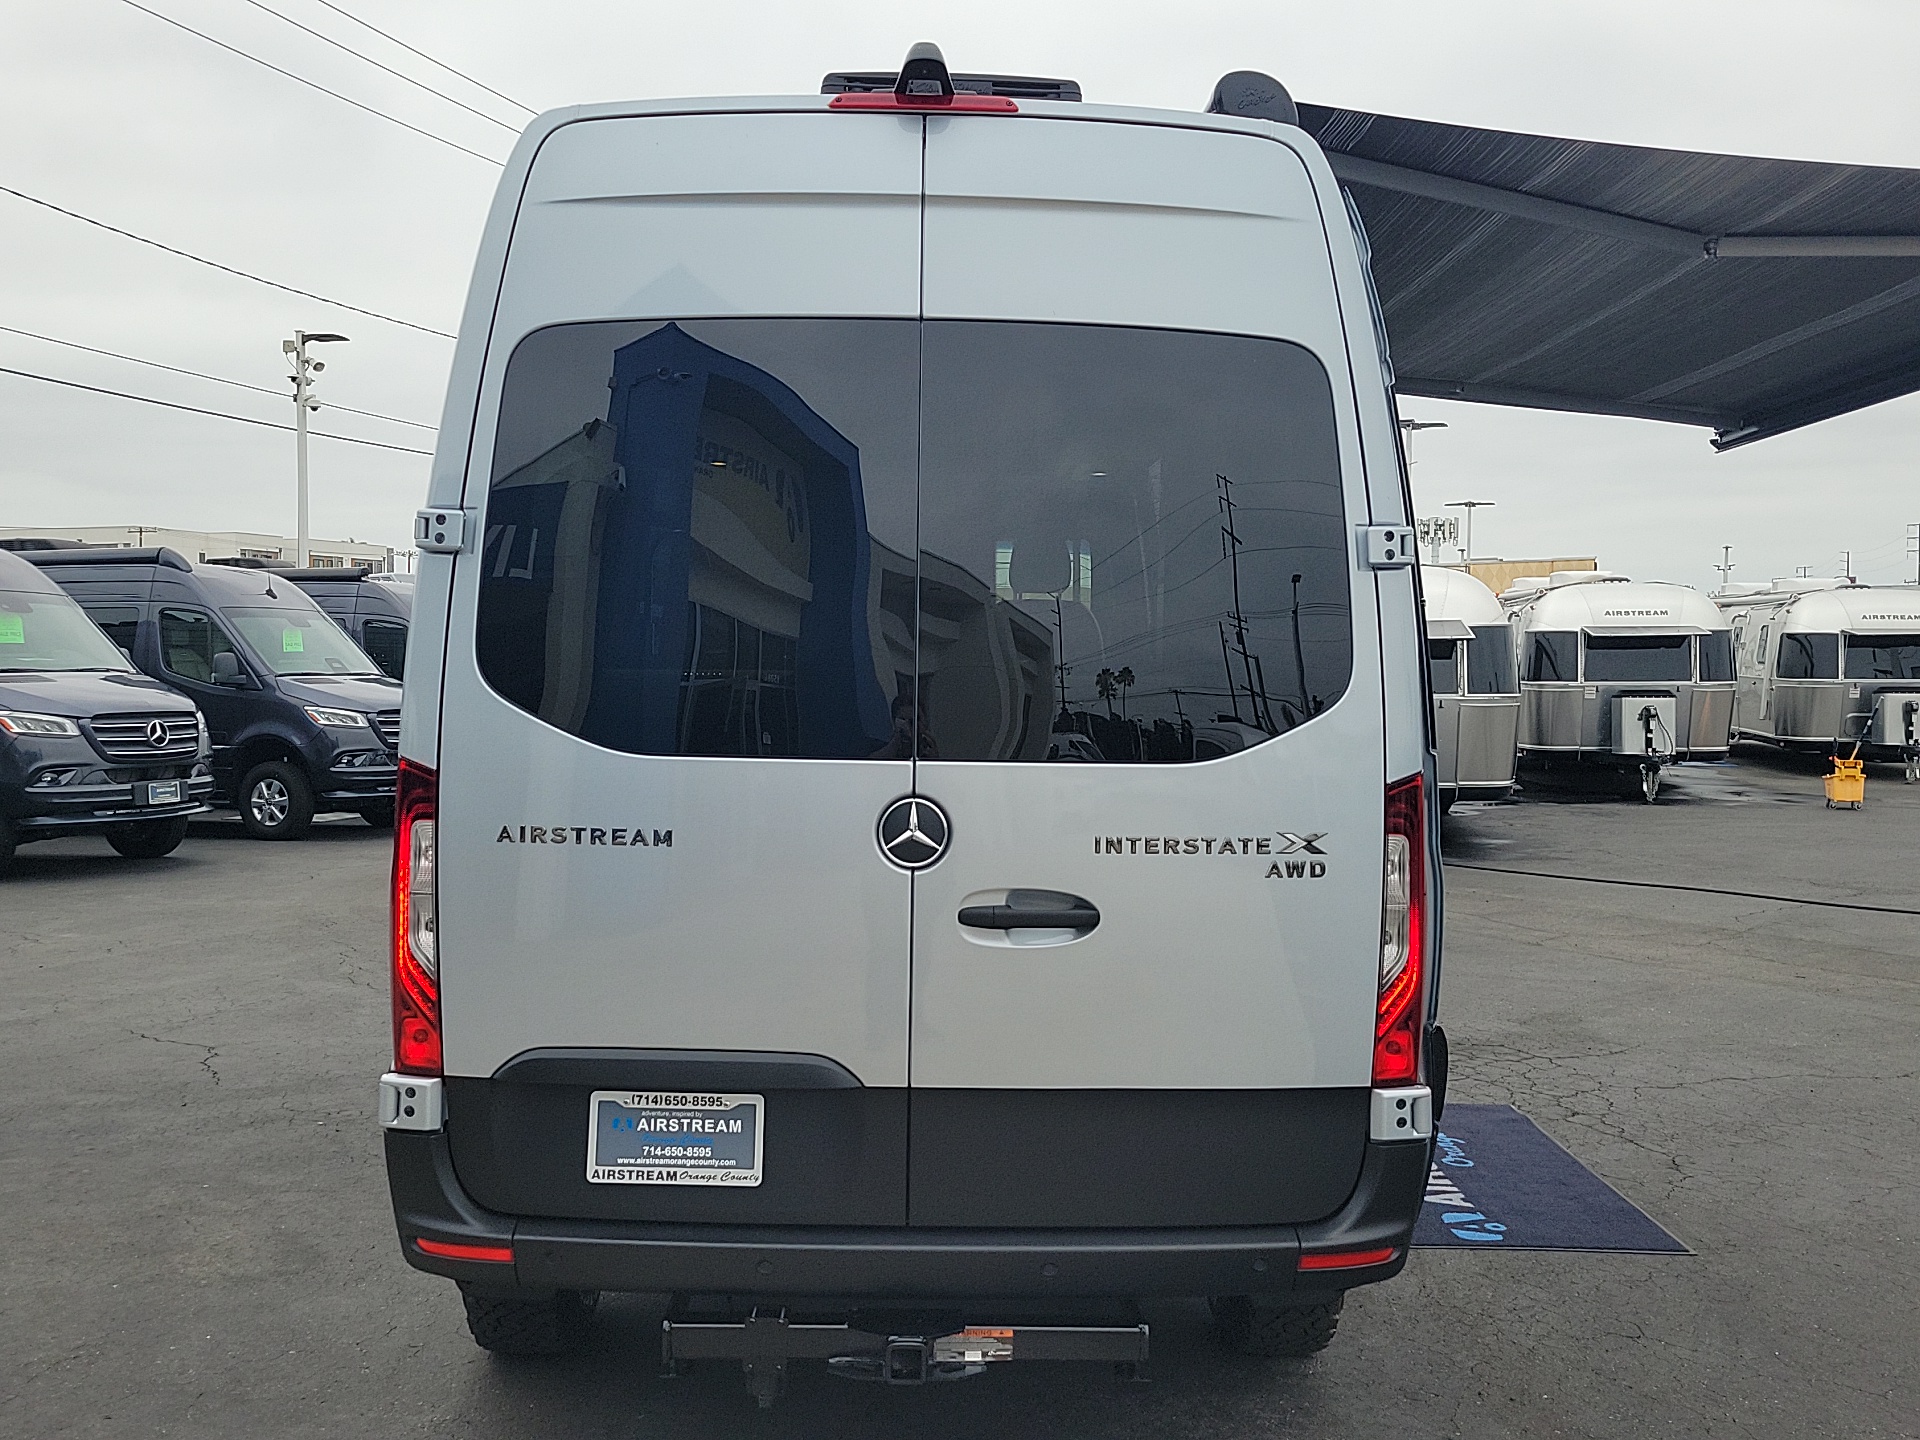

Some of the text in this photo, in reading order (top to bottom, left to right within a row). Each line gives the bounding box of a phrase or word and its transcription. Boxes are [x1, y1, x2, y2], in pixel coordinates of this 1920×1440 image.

[497, 825, 673, 847] AIRSTREAM
[1094, 835, 1272, 855] INTERSTATE
[1265, 860, 1327, 879] AWD
[631, 1094, 723, 1107] (714)650-8595
[695, 1111, 703, 1119] by
[637, 1117, 742, 1133] AIRSTREAM
[642, 1146, 712, 1158] 714-650-8595
[616, 1156, 737, 1167] www.airstreamorangecounty.com
[591, 1169, 760, 1183] AIRSTREAM Orange County
